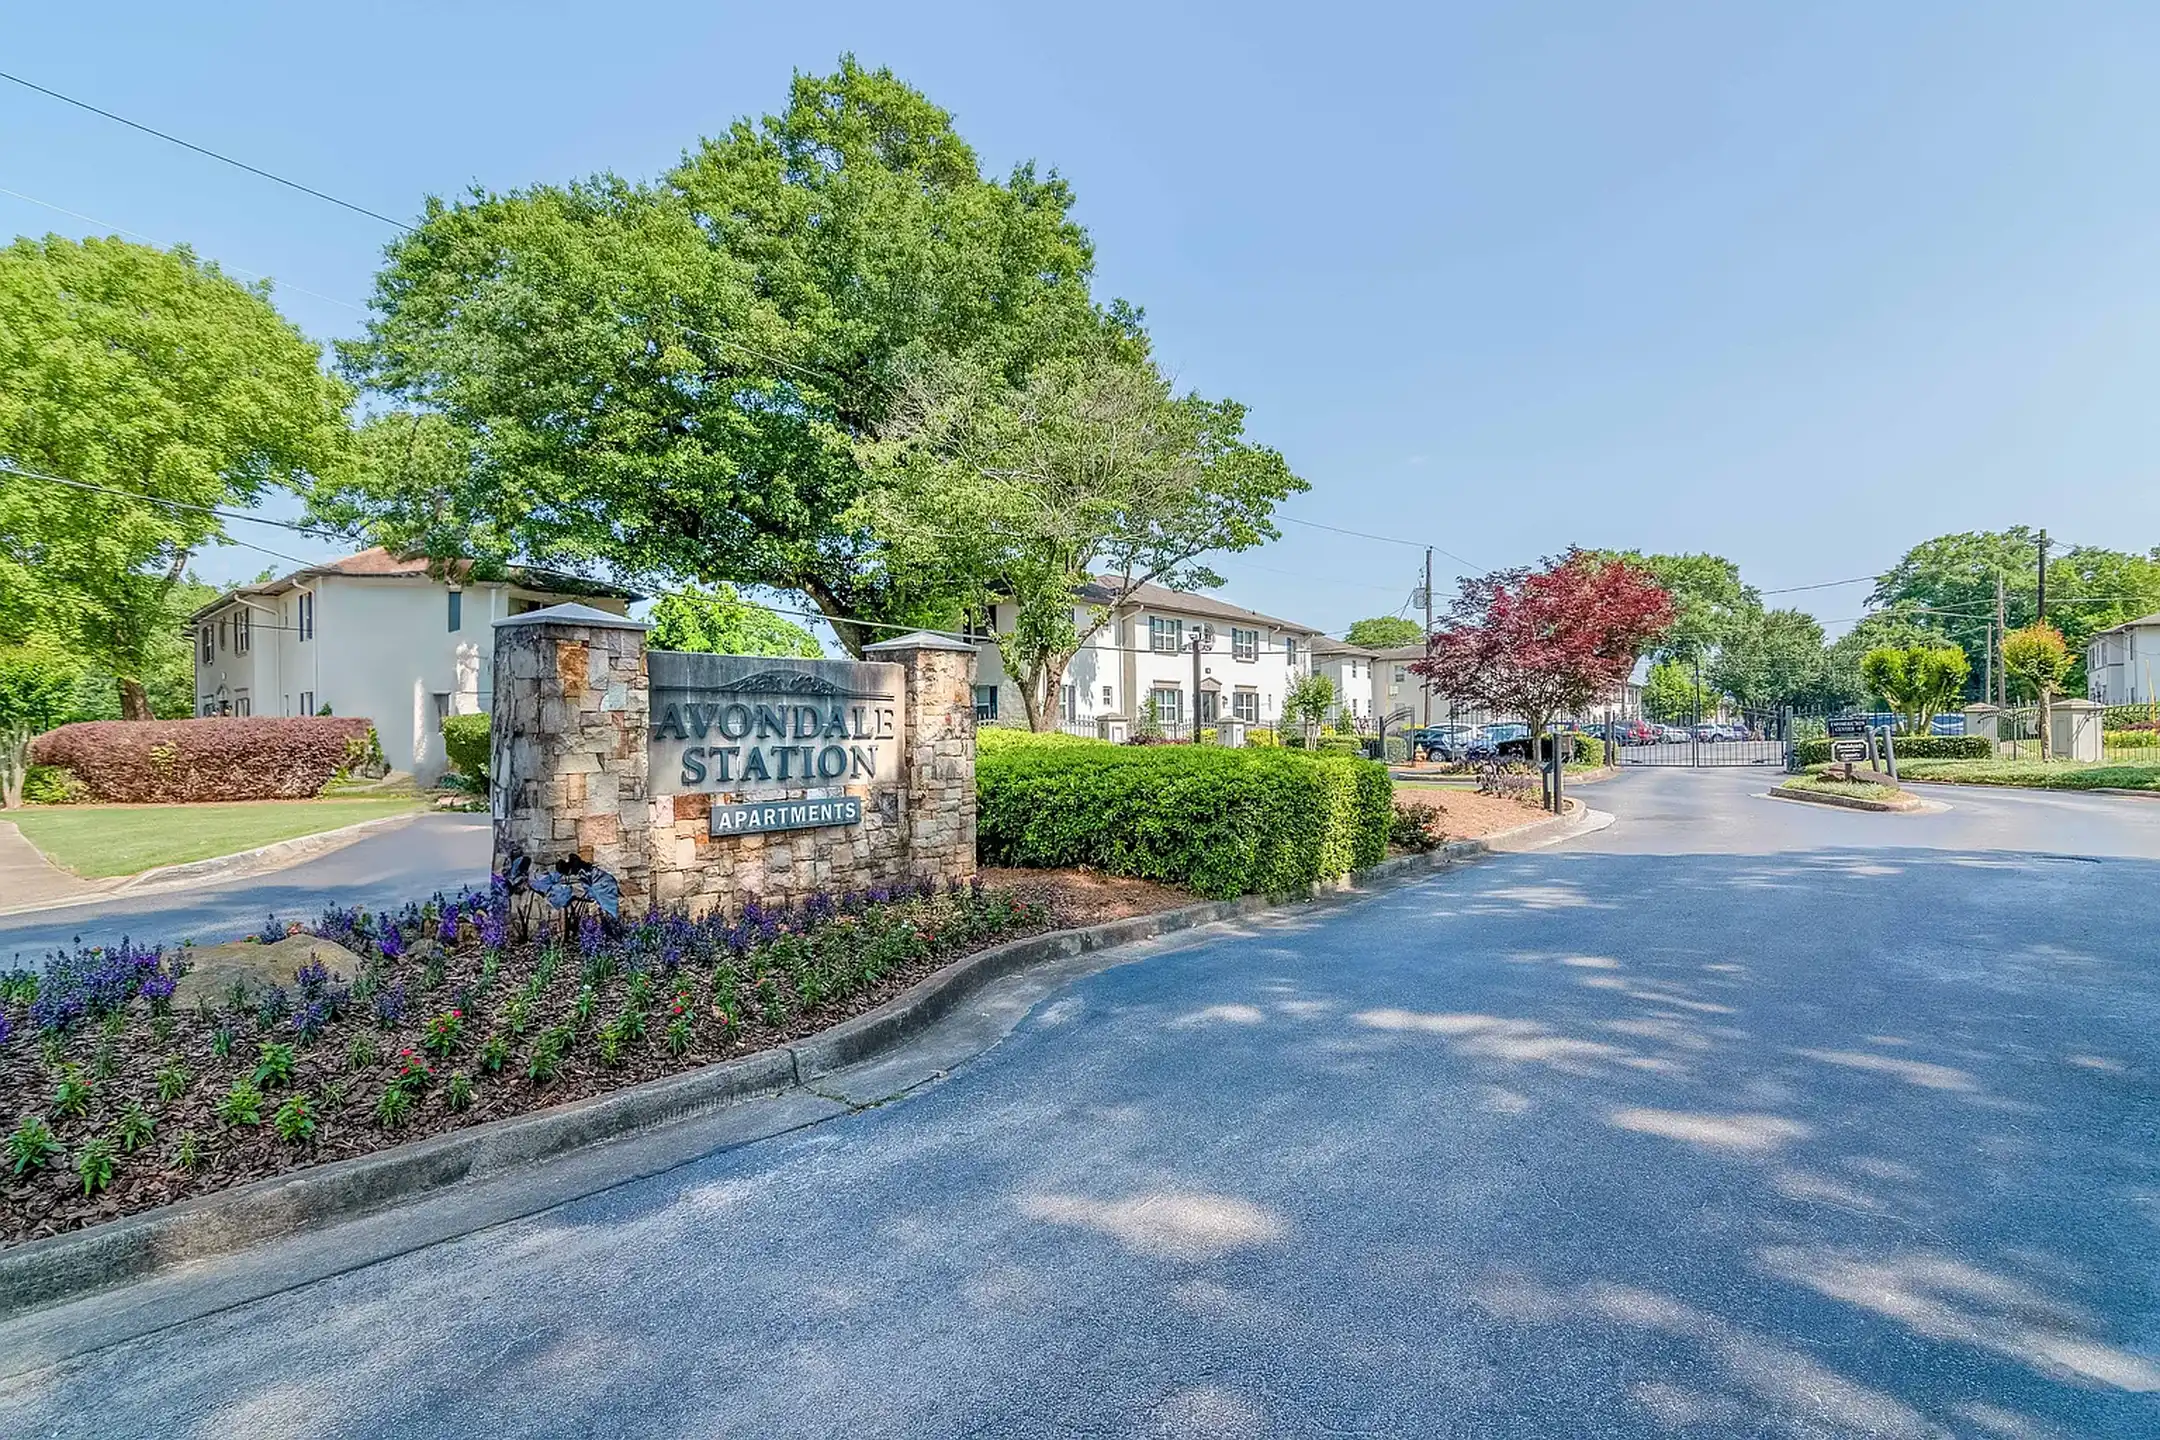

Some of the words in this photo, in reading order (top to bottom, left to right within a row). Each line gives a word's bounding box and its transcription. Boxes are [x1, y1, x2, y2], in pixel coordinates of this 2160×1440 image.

[653, 702, 895, 741] AVONDALE
[681, 745, 879, 784] STATION
[718, 802, 857, 831] APARTMENTS
